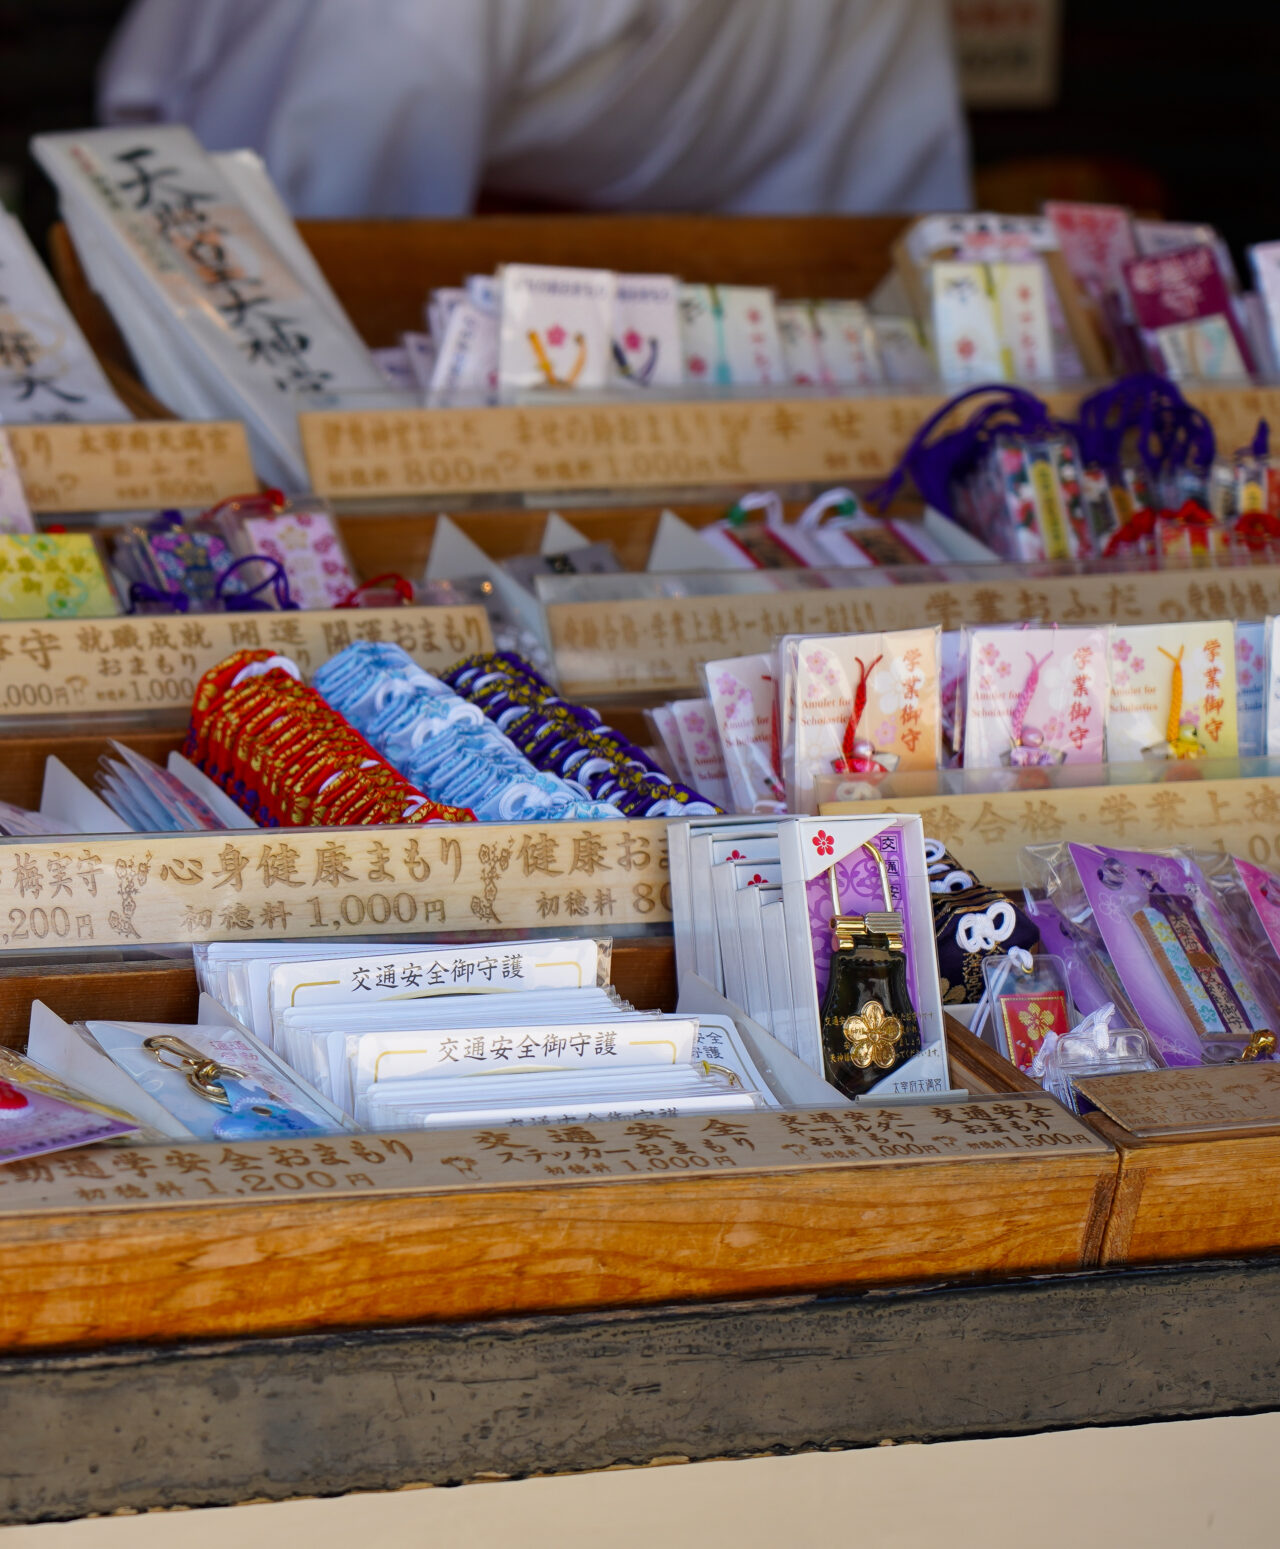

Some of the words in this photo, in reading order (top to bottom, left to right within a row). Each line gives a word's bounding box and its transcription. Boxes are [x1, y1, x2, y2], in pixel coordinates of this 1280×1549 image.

[1069, 646, 1094, 750] 学業御守
[1203, 638, 1224, 742] 学業御守
[159, 835, 466, 891] 心身健康まもり
[180, 890, 447, 933] 初穂料1,000円
[352, 953, 526, 993] 交通安全御守護
[438, 1029, 619, 1062] 交通安全御守護
[777, 1109, 904, 1126] 交通安全
[787, 1121, 917, 1137] キーホルダー
[931, 1101, 1055, 1125] 交通安全
[961, 1119, 1051, 1135] おまもり
[472, 1118, 752, 1150] 交通安全
[496, 1136, 756, 1164] ステッカーおまもり
[808, 1130, 915, 1147] おまもり
[966, 1132, 1093, 1150] 初穂料1,500円
[75, 1169, 376, 1202] 初穂料1,200円
